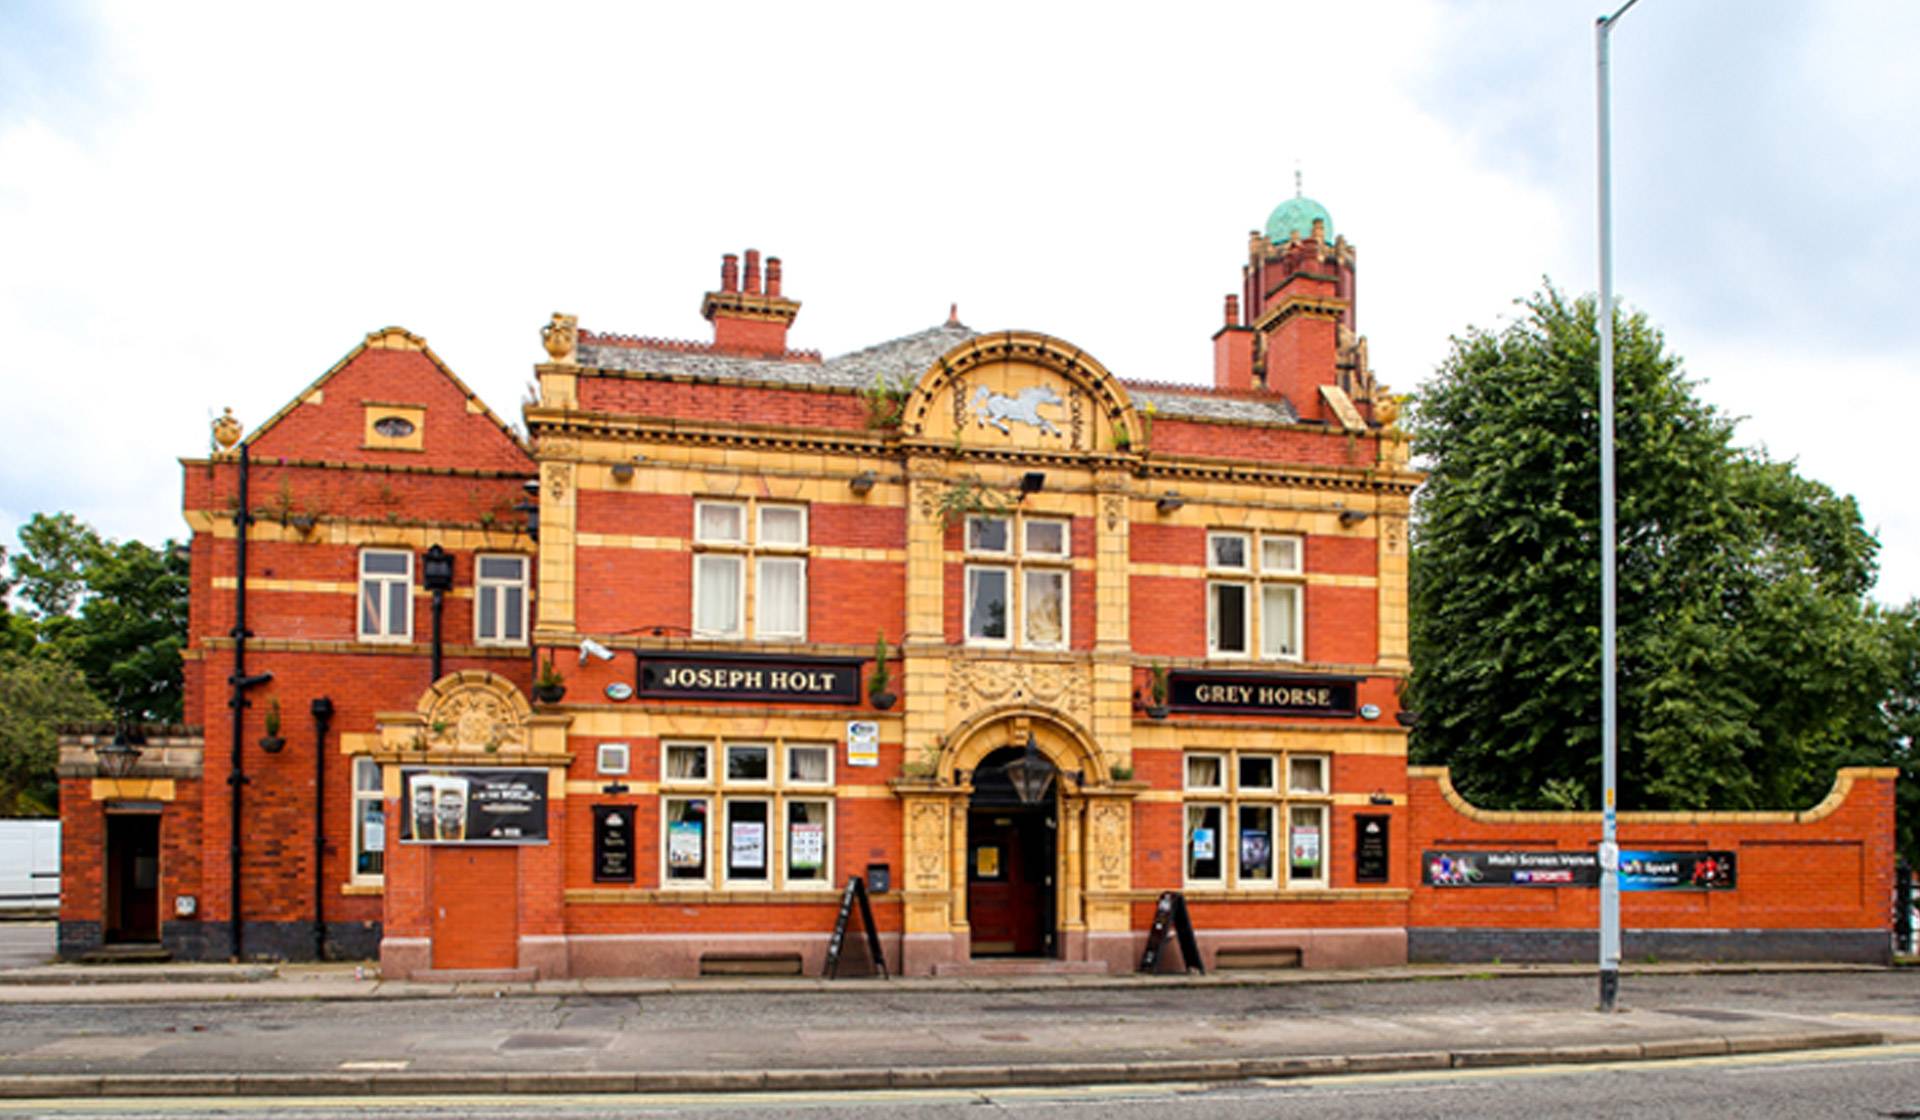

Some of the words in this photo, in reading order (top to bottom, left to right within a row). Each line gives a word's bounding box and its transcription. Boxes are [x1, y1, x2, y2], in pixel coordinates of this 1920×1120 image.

[664, 668, 763, 688] JOSEPH
[770, 671, 836, 691] HOLT
[1195, 684, 1253, 703] GREY
[1258, 687, 1331, 706] HORSE
[1488, 854, 1517, 866] Multi
[1520, 854, 1559, 866] Screen
[1560, 855, 1595, 867] Venue
[1645, 861, 1679, 875] Sport
